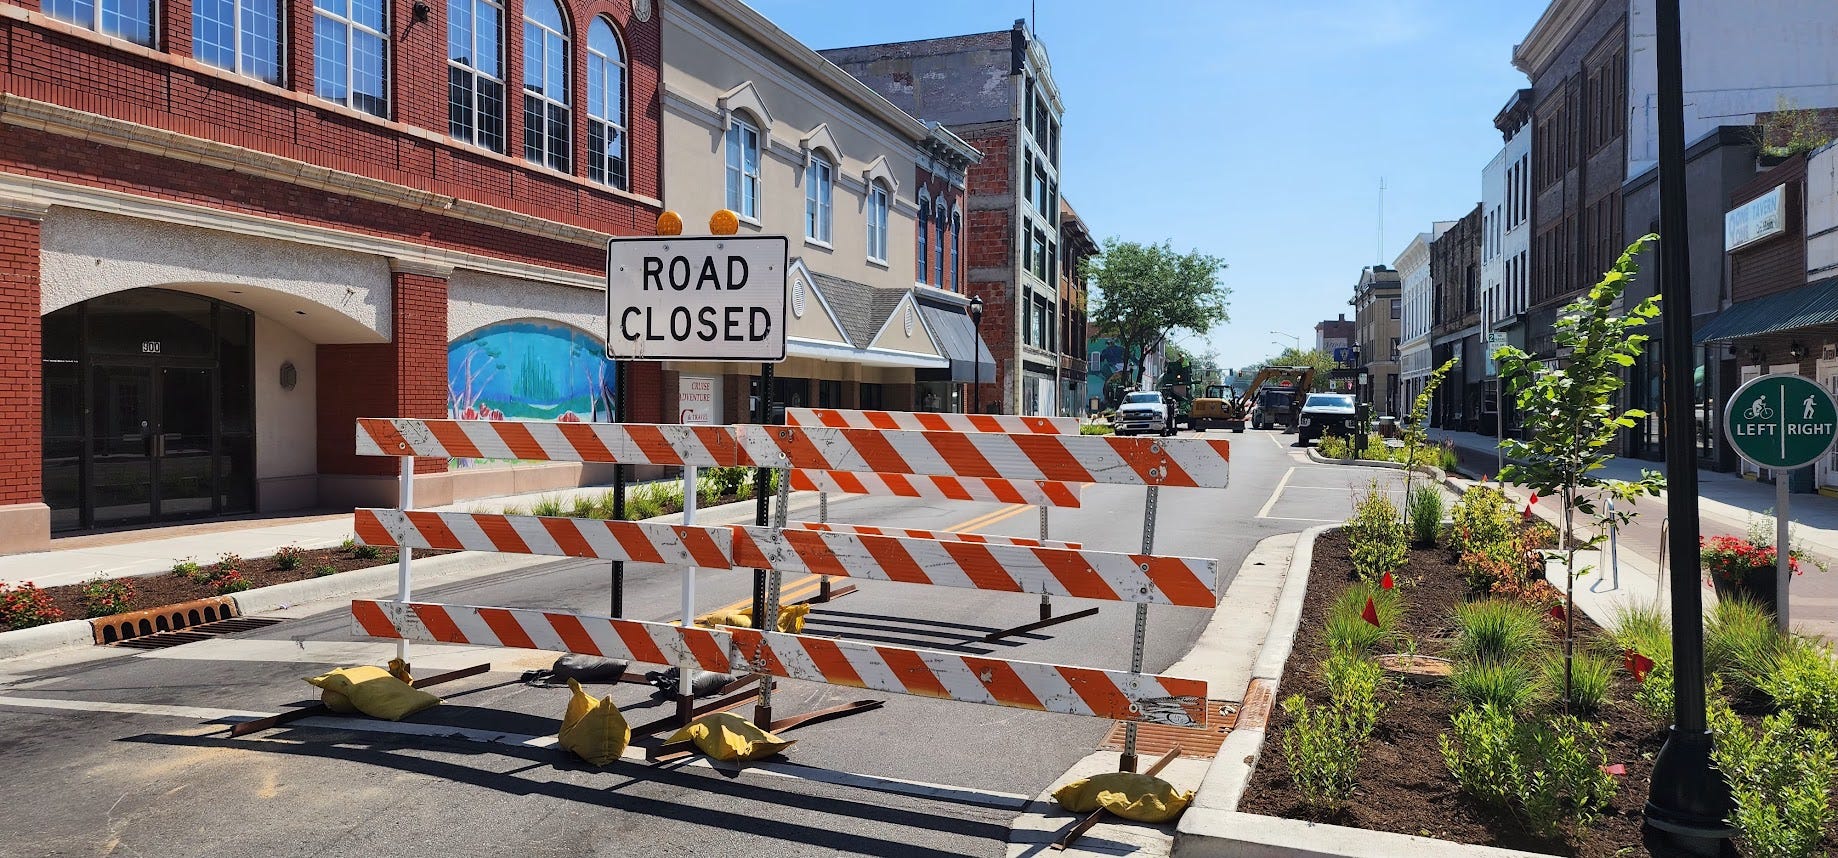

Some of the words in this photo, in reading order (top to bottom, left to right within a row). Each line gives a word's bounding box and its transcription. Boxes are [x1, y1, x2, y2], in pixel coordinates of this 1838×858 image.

[1752, 195, 1777, 220] TAVERN
[643, 256, 748, 291] ROAD
[621, 306, 771, 341] CLOSED
[142, 341, 160, 353] 900
[691, 381, 710, 390] CRUISE
[1736, 423, 1777, 435] LEFT
[1787, 423, 1833, 435] RIGHT
